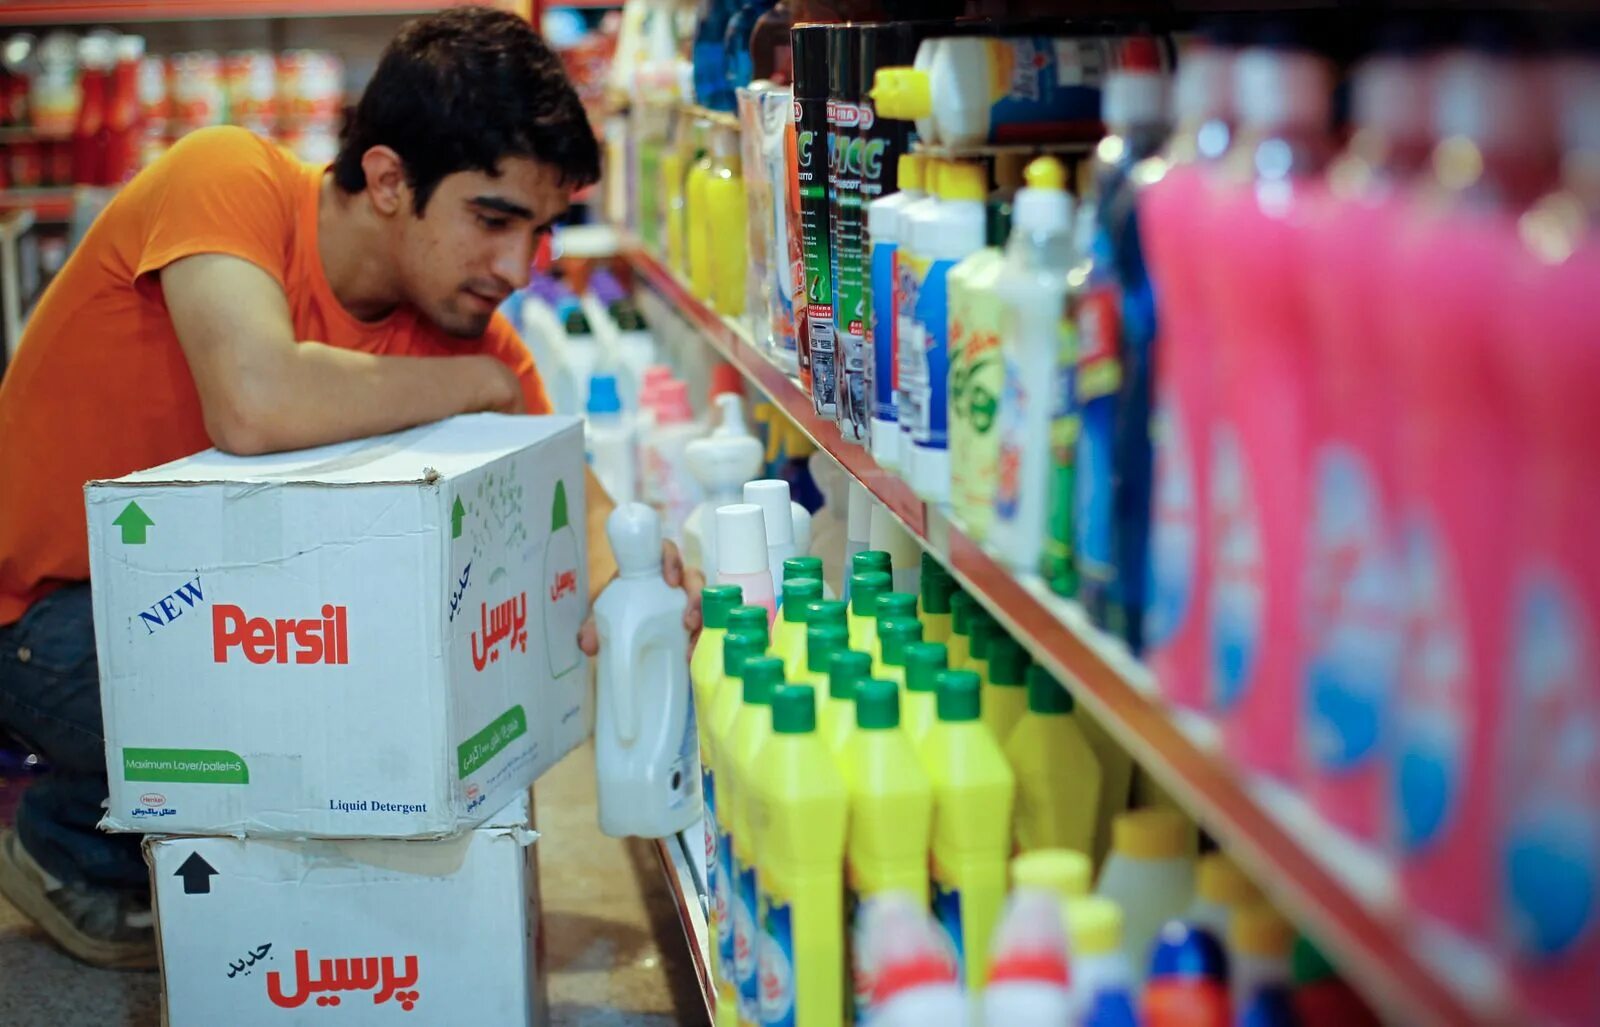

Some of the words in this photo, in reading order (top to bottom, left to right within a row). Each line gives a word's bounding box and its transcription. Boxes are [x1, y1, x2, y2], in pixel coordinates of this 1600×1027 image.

[138, 576, 205, 635] NEW
[212, 604, 349, 664] Persil
[471, 591, 528, 672] پرسیل
[126, 759, 172, 769] Maximum
[173, 761, 241, 772] Layer/pallet=5
[329, 799, 368, 813] Liquid
[371, 801, 428, 814] Detergent
[227, 942, 273, 978] جدید
[266, 949, 420, 1012] پرسیل
